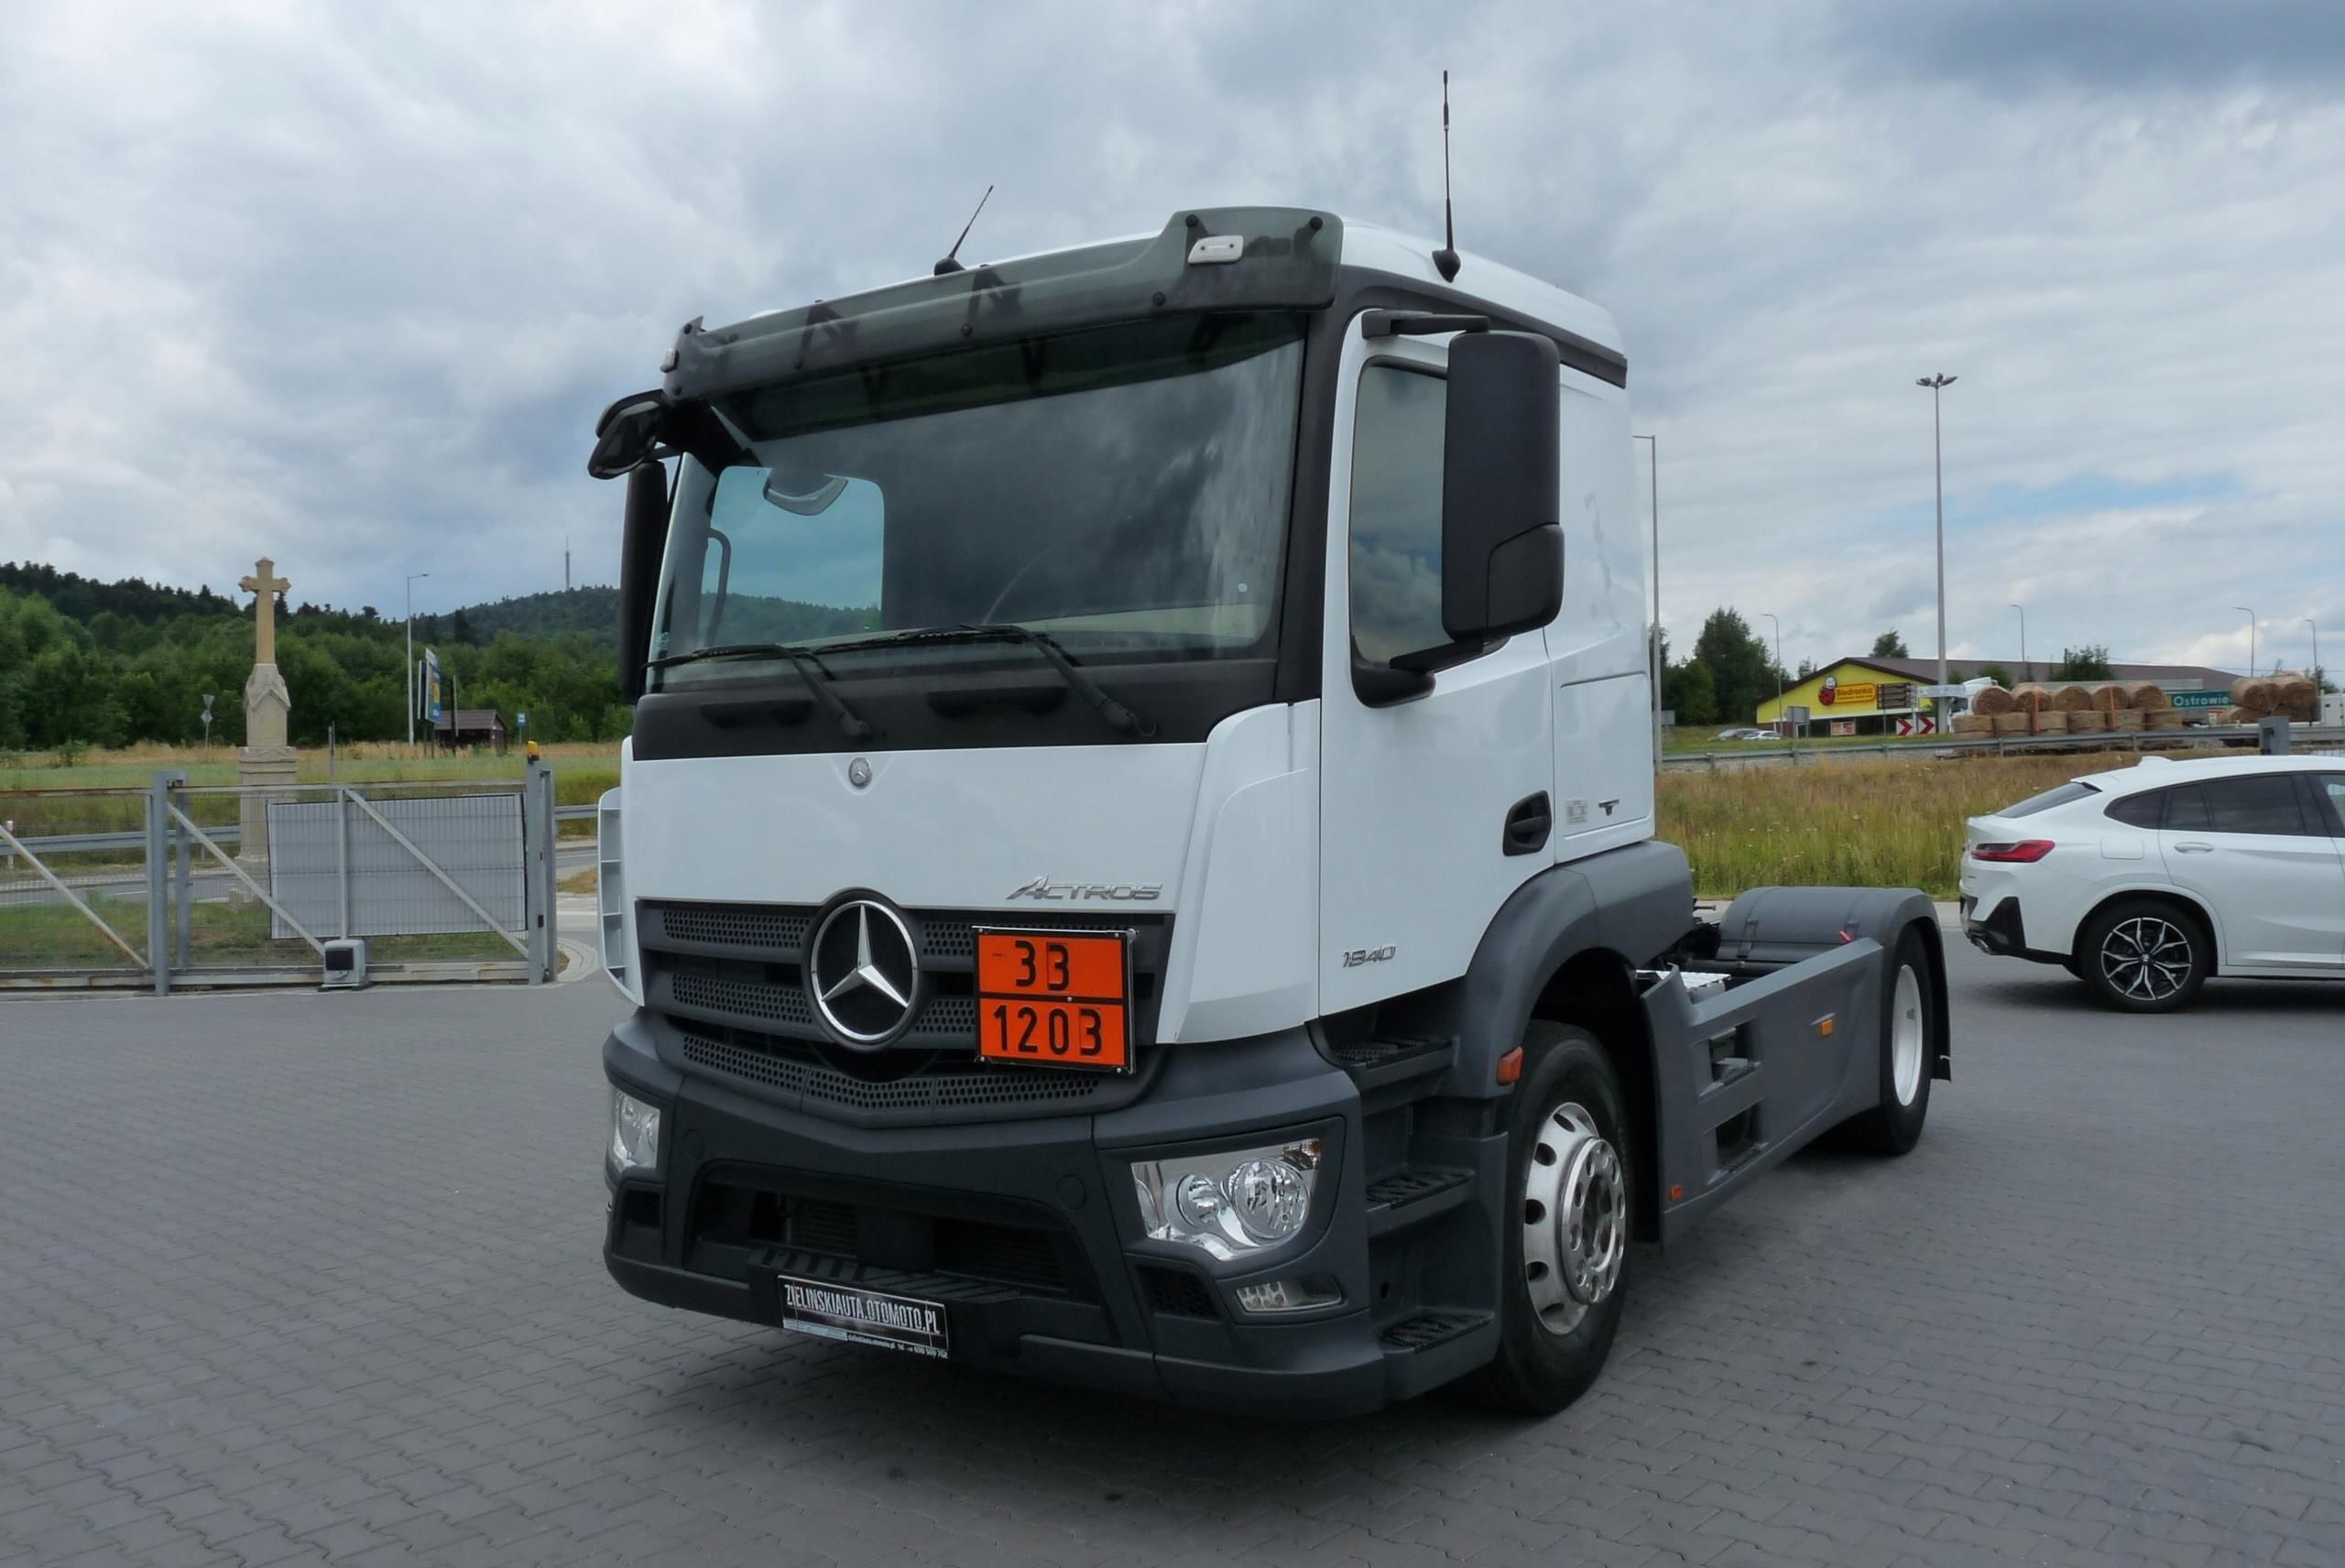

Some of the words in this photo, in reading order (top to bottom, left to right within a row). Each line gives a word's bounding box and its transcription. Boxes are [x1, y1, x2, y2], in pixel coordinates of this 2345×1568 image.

[2173, 694, 2231, 706] Ostrowie
[1006, 874, 1162, 900] ACTROS
[1014, 940, 1070, 991] 33
[1342, 946, 1396, 967] 1840
[993, 1004, 1103, 1056] 1203
[784, 1284, 941, 1334] ZIELINSKIAUTA.OTOMOTO.PL
